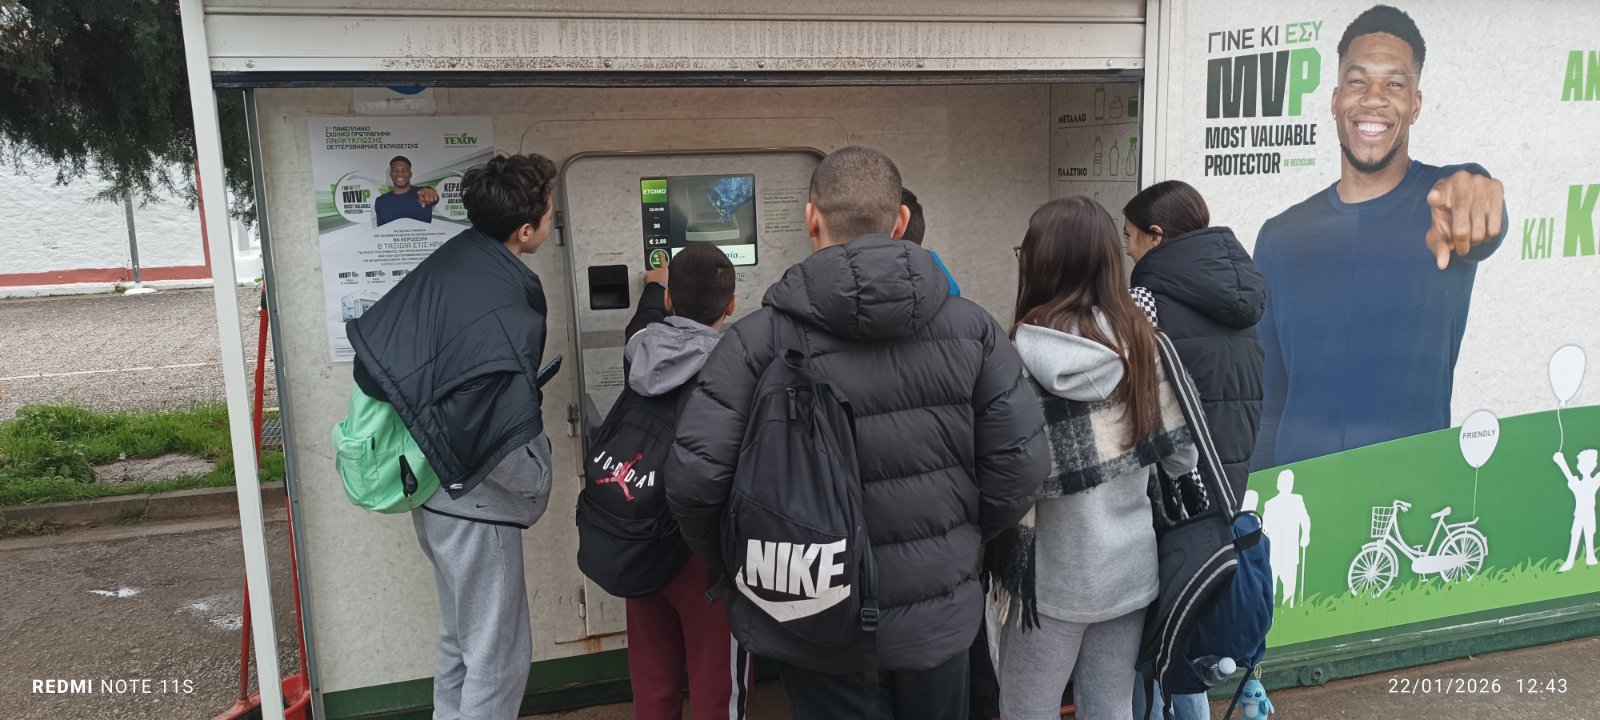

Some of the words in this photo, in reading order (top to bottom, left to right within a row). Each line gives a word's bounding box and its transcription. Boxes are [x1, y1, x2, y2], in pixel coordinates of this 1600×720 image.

[1208, 28, 1255, 53] ΓΙΝΕ
[1261, 25, 1279, 47] ΚΙ
[1285, 20, 1323, 44] ΕΣΥ
[1206, 47, 1322, 119] MVP
[1205, 126, 1247, 149] MOST
[1250, 123, 1317, 148] VALUABLE
[1205, 152, 1281, 177] PROTECTOR
[342, 189, 371, 203] MVP
[1521, 217, 1554, 260] ΚΑΙ
[1462, 429, 1496, 439] FRIENDLY
[747, 538, 846, 598] NIKE
